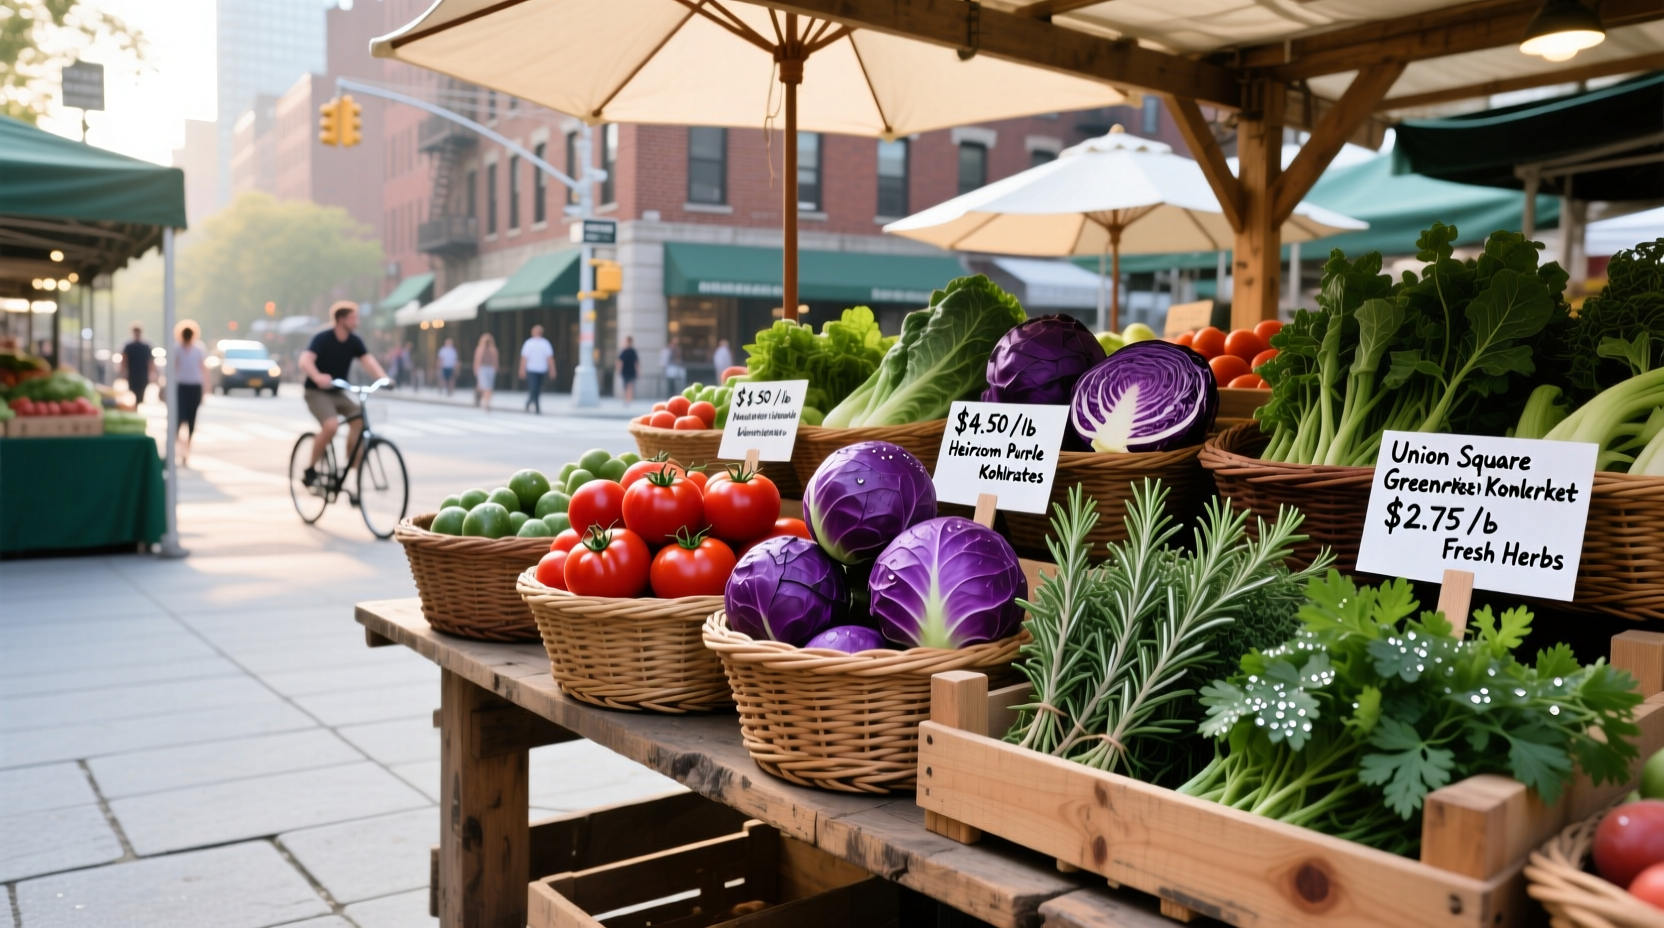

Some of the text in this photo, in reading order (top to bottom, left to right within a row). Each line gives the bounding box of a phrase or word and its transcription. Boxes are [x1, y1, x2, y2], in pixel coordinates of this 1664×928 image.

[1391, 439, 1532, 476] Union Square
[1442, 537, 1564, 571] Fresh Herbs
